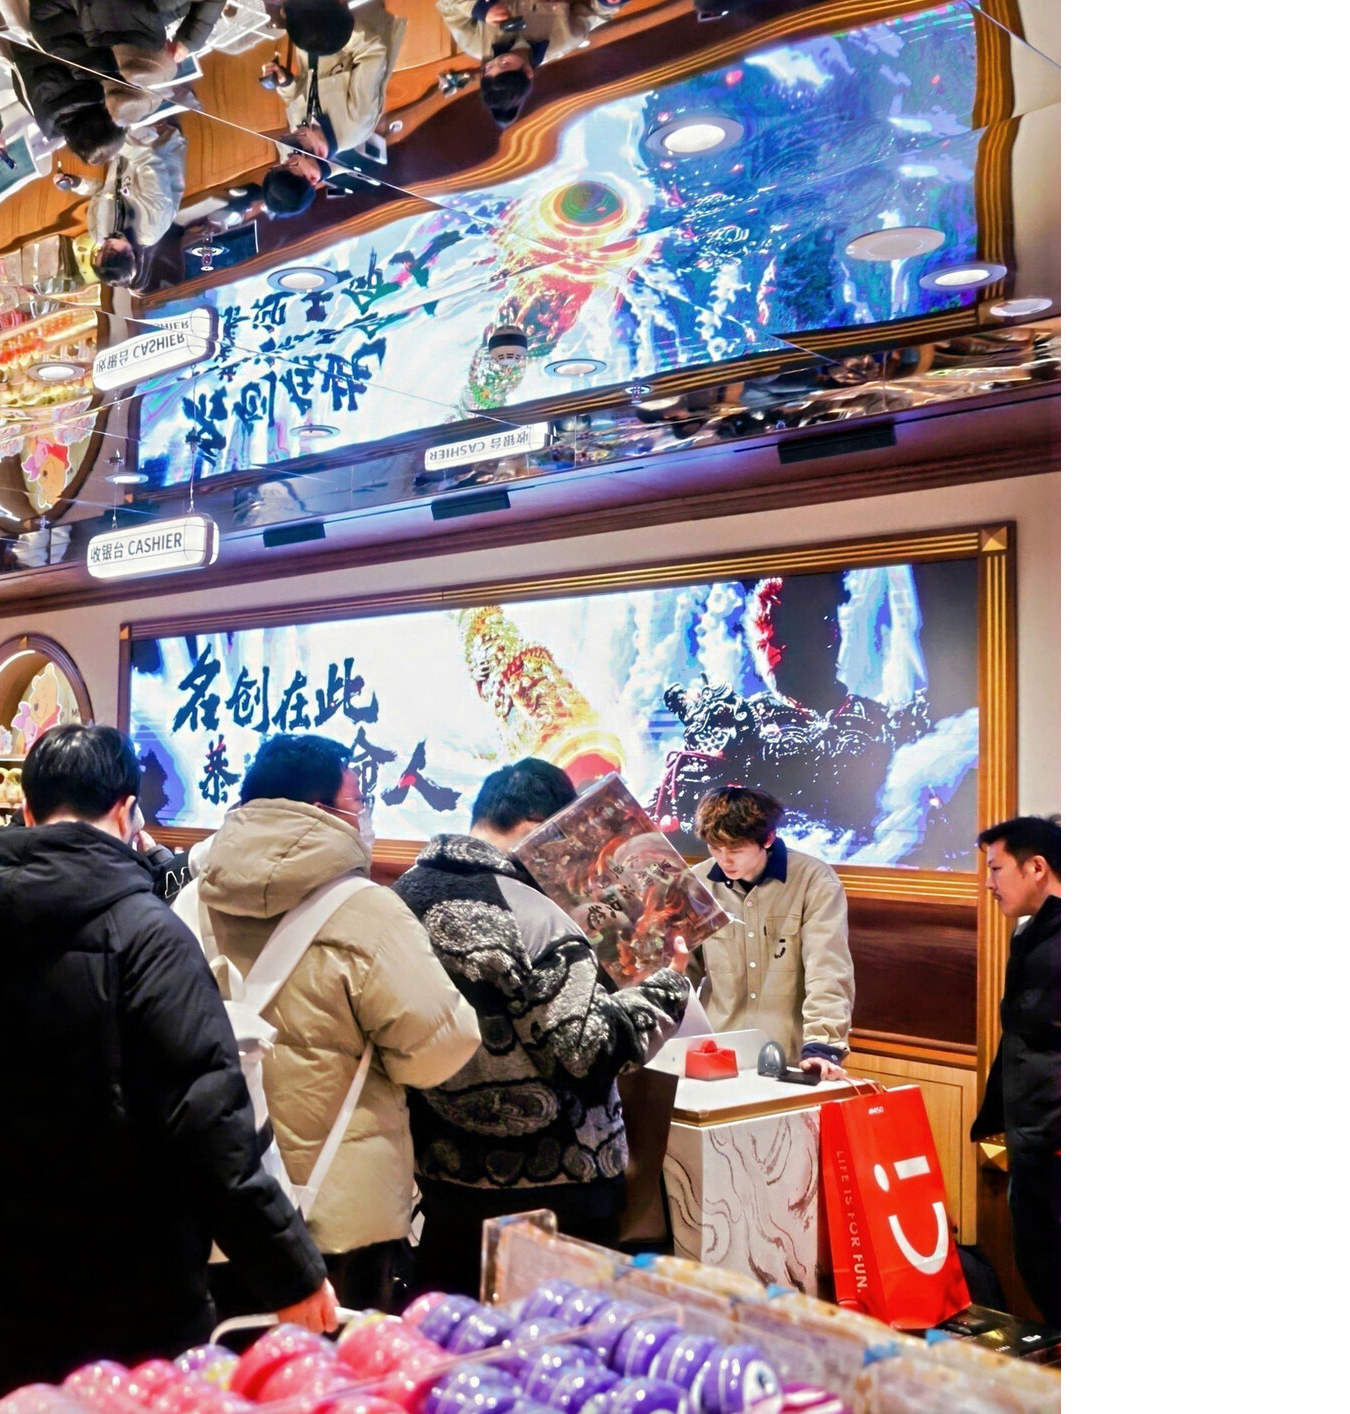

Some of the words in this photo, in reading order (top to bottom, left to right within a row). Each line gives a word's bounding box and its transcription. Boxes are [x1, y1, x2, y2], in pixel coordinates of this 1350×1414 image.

[430, 441, 486, 461] CASHIER
[90, 541, 124, 563] 收银台
[128, 532, 182, 556] CASHIER
[171, 643, 379, 734] 名创在此
[836, 1150, 850, 1183] LIFE
[844, 1189, 853, 1206] IS
[847, 1213, 861, 1247] FOR
[852, 1253, 868, 1293] FUN.
